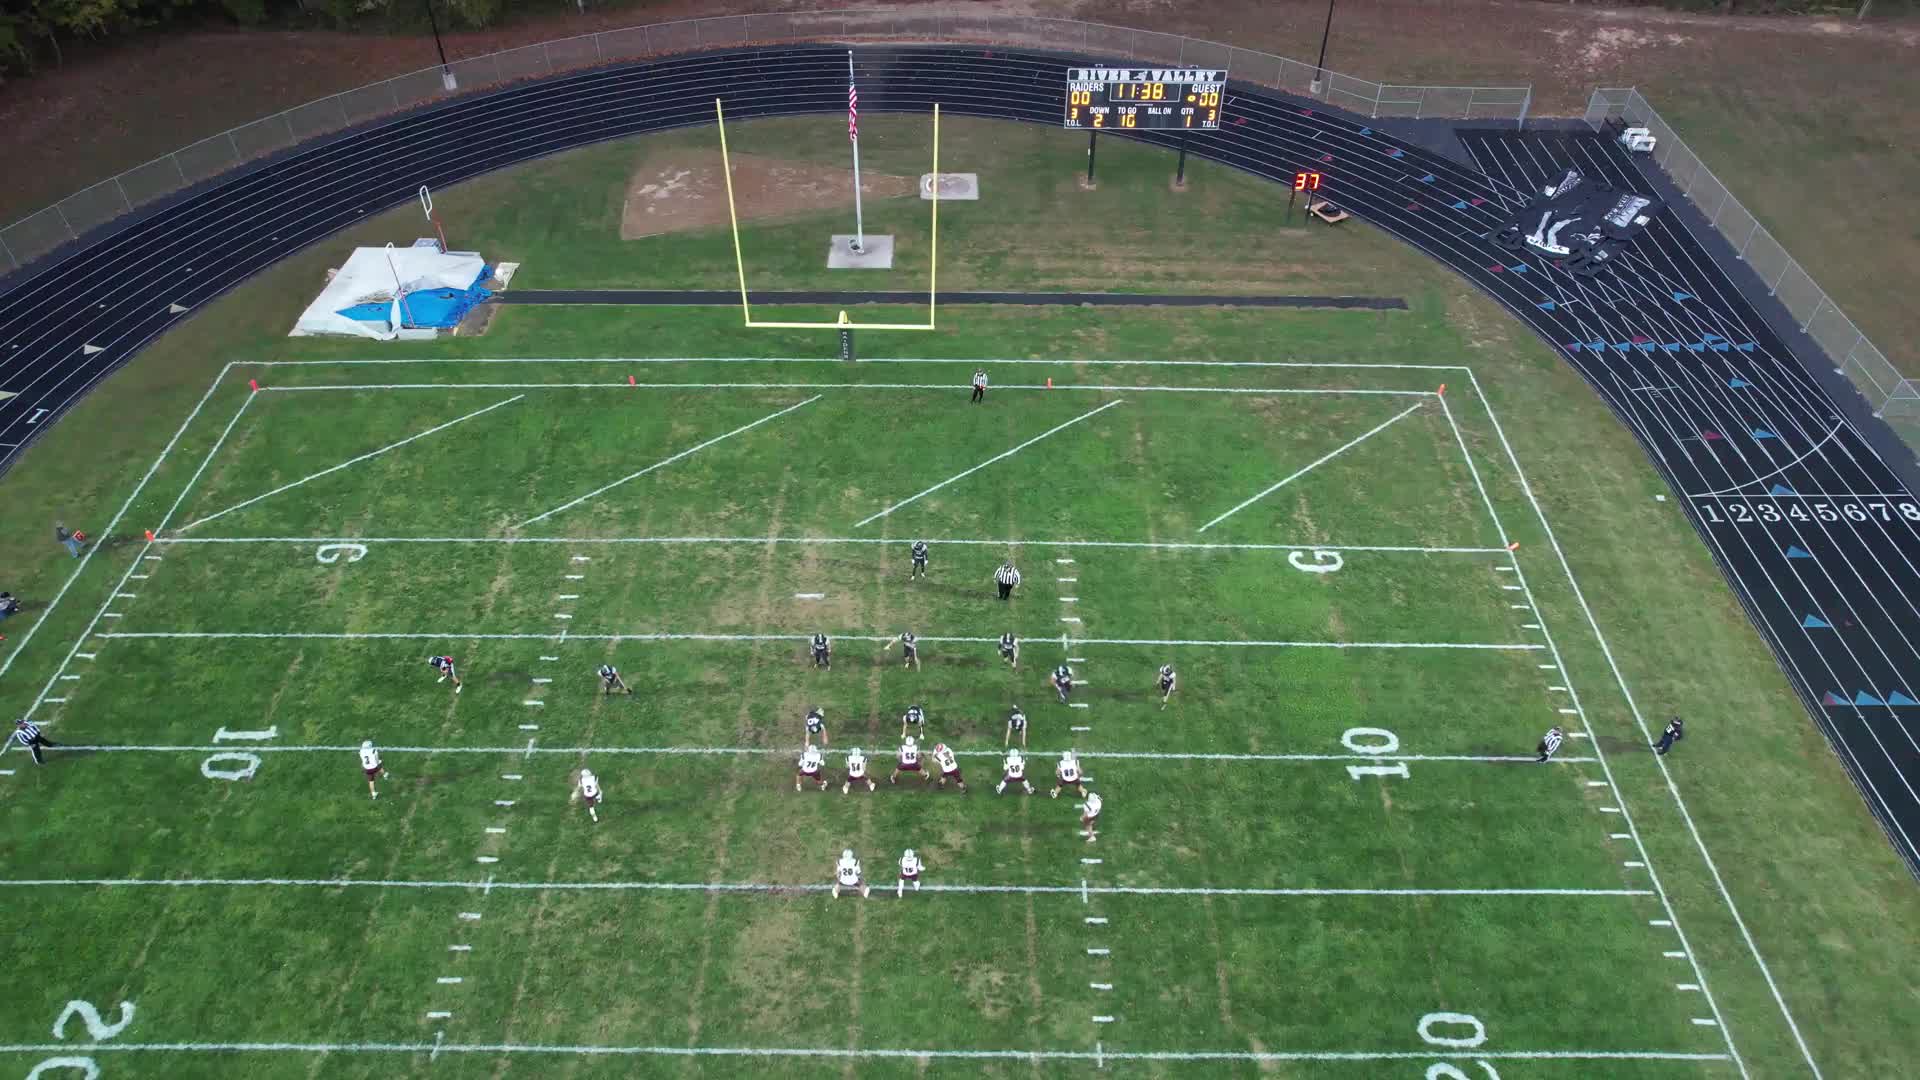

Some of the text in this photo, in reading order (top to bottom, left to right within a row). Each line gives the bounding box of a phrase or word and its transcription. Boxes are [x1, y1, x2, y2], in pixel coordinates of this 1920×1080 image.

[1078, 70, 1216, 82] RIVER VALLEY
[1070, 83, 1104, 92] RAIDERS
[1192, 84, 1220, 93] GUEST
[1071, 92, 1090, 105] 00
[1199, 93, 1218, 106] 00
[1071, 108, 1078, 119] 3
[1208, 110, 1216, 120] 3
[1094, 115, 1103, 127] 2
[1121, 115, 1135, 127] 10
[1186, 116, 1191, 127] 1
[1295, 173, 1320, 190] 37
[1702, 503, 1920, 522] 1 2 3 4 5 6 7 8
[1288, 551, 1344, 573] G
[201, 725, 278, 781] 10
[1340, 726, 1410, 781] 10
